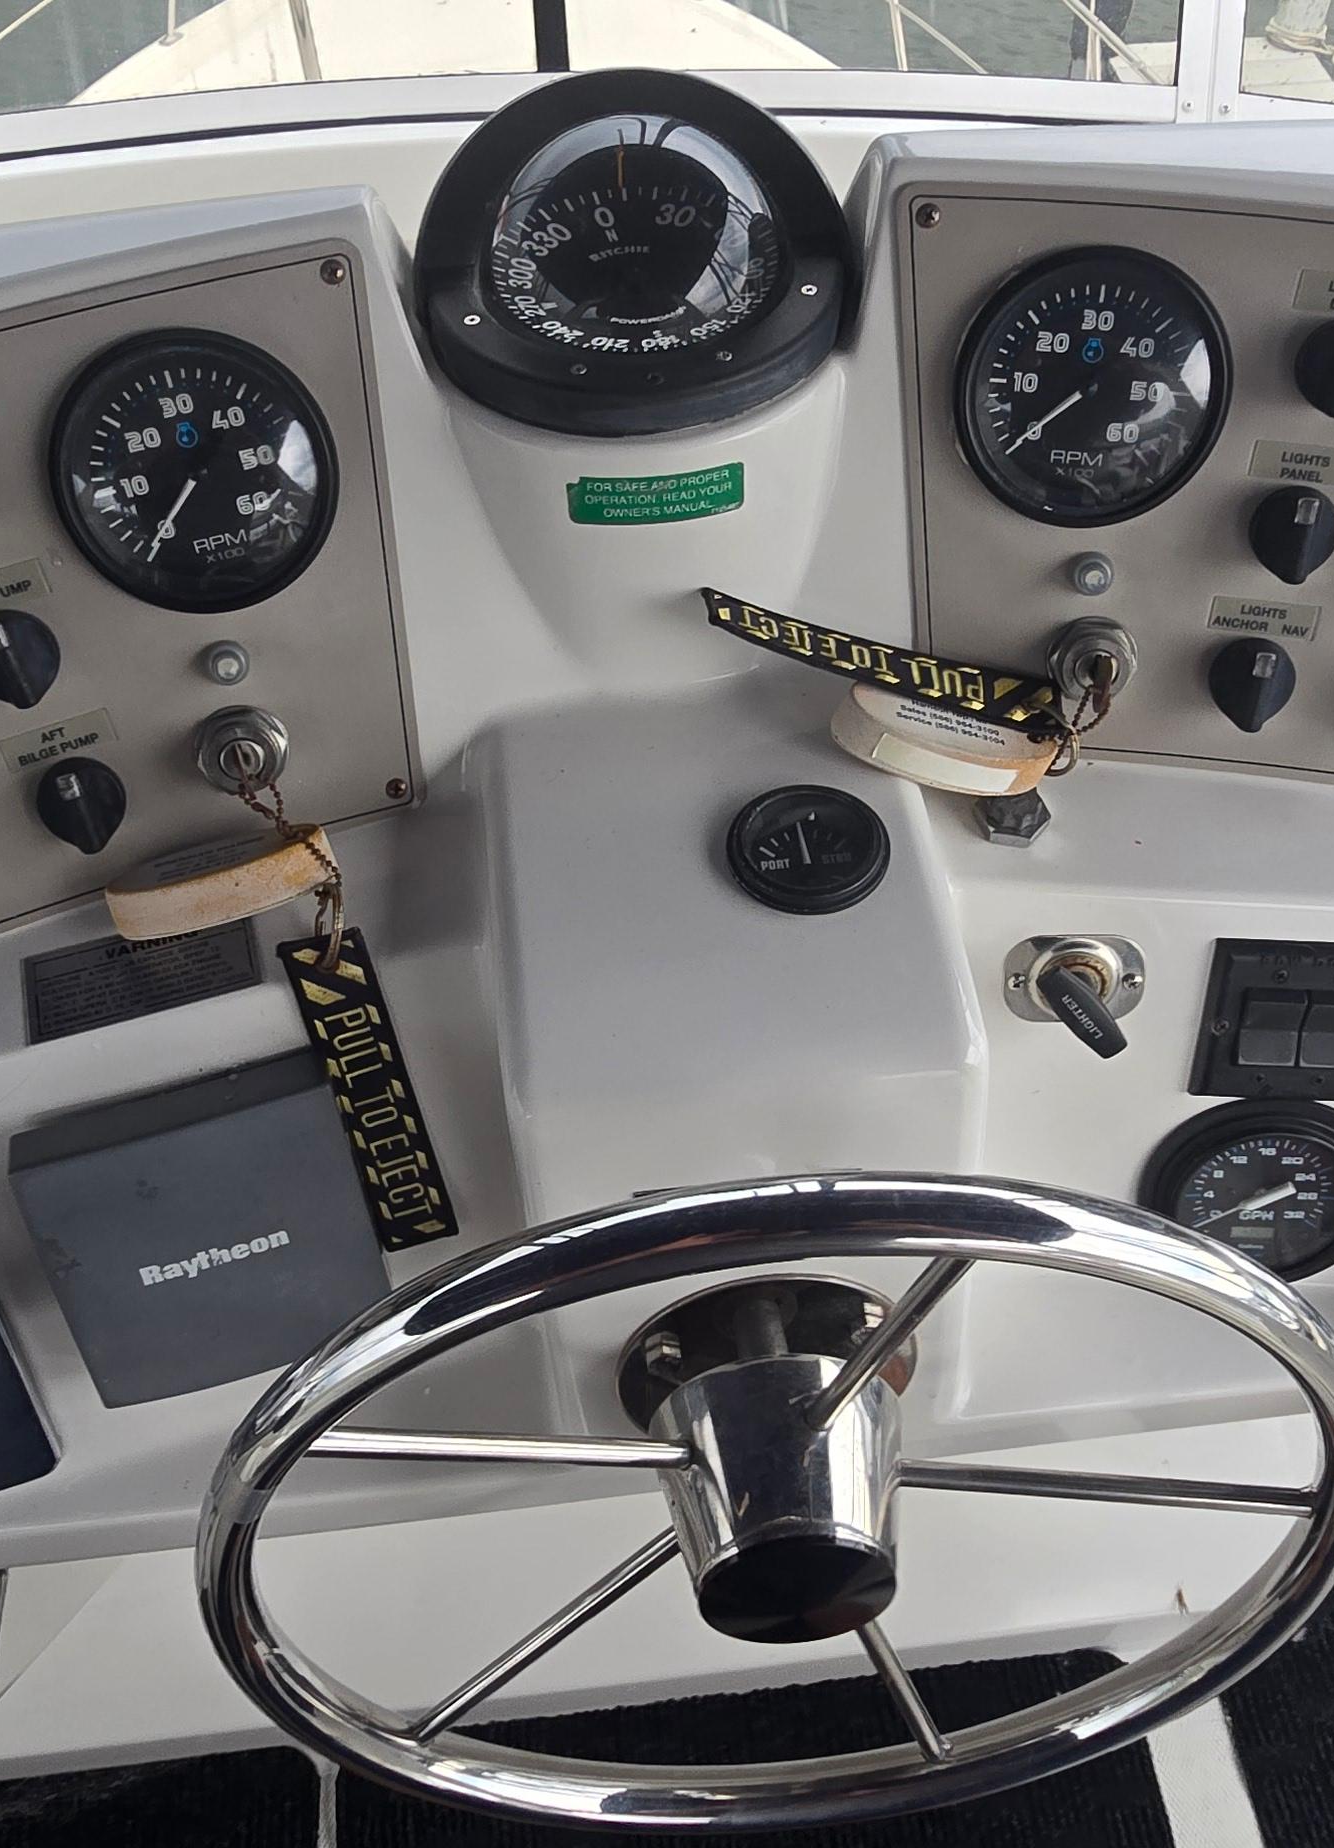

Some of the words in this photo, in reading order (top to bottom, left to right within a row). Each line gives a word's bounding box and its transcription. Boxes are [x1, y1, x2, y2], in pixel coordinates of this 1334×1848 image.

[594, 207, 615, 227] 0
[655, 203, 696, 228] 30
[521, 222, 572, 257] 330
[605, 229, 619, 242] N
[588, 245, 650, 262] RITCHIE
[508, 258, 537, 289] 300
[514, 295, 546, 317] 270
[542, 320, 584, 342] 240
[690, 319, 727, 336] 150
[1081, 310, 1114, 331] 30
[591, 337, 630, 350] 210
[1036, 332, 1070, 353] 20
[1120, 337, 1154, 358] 40
[1013, 373, 1038, 392] 10
[1130, 381, 1160, 401] 50
[159, 393, 194, 418] 30
[211, 406, 245, 430] 40
[124, 427, 161, 453] 20
[1026, 422, 1042, 440] 0
[1106, 423, 1139, 443] 60
[238, 445, 273, 471] 50
[1051, 450, 1103, 466] RPM
[1281, 451, 1330, 467] LIGHTS
[587, 482, 612, 492] FOR
[614, 481, 648, 492] SAFE
[651, 479, 676, 491] AND
[680, 469, 729, 488] PROPER
[1280, 467, 1323, 483] PANEL
[120, 475, 150, 498] 10
[663, 491, 695, 502] READ
[699, 482, 732, 498] YOUR
[236, 491, 271, 515] 60
[603, 506, 660, 518] OWNER'S
[193, 529, 247, 554] RPM
[1240, 605, 1287, 619] LIGHTS
[738, 606, 839, 659] EJECT
[1212, 616, 1269, 632] ANCHOR
[1282, 624, 1310, 638] NAV
[850, 645, 894, 676] TO
[901, 657, 985, 703] PULL
[896, 712, 932, 726] Service
[900, 704, 926, 717] Sales
[40, 727, 66, 744] AFT
[19, 745, 60, 767] BILGE
[60, 732, 99, 754] PUMP
[760, 858, 790, 871] PORT
[821, 852, 851, 865] STBD
[1062, 994, 1103, 1040] LIGHTER
[324, 1007, 383, 1088] PULL
[360, 1085, 400, 1128] TO
[1229, 1156, 1248, 1164] 12
[1258, 1147, 1277, 1156] 16
[1281, 1156, 1304, 1165] 20
[368, 1135, 433, 1221] EJECT
[1295, 1173, 1316, 1181] 24
[1203, 1190, 1215, 1199] 4
[1239, 1210, 1274, 1221] GPH
[138, 1229, 290, 1287] Raytheon
